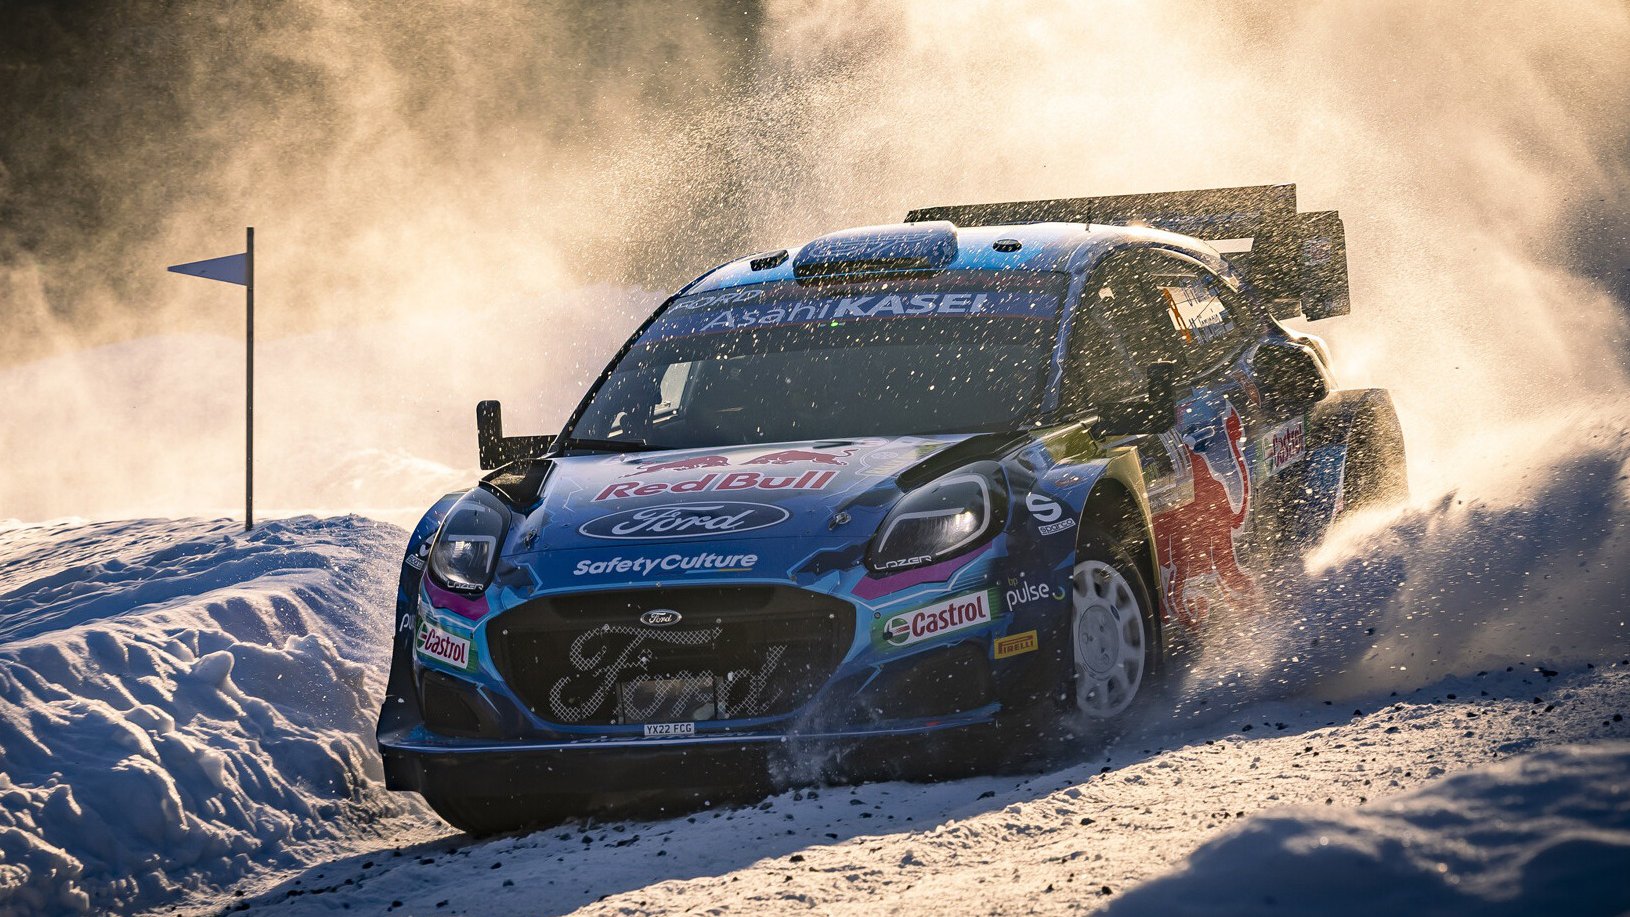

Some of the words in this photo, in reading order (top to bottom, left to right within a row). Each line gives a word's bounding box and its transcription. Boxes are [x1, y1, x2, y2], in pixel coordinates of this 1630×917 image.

[700, 299, 833, 332] Asahi
[833, 294, 989, 316] KASEI
[611, 504, 756, 535] Ford
[1041, 519, 1073, 535] sparco
[573, 552, 758, 577] SafetyCulture
[874, 555, 933, 571] LAZER
[1006, 580, 1050, 612] pulse
[648, 611, 673, 624] Ford
[912, 596, 987, 637] Castrol
[424, 628, 466, 664] Castrol
[998, 635, 1034, 655] PIRELLI
[549, 625, 788, 722] Ford
[646, 723, 671, 734] YX22
[673, 722, 692, 733] FCG
